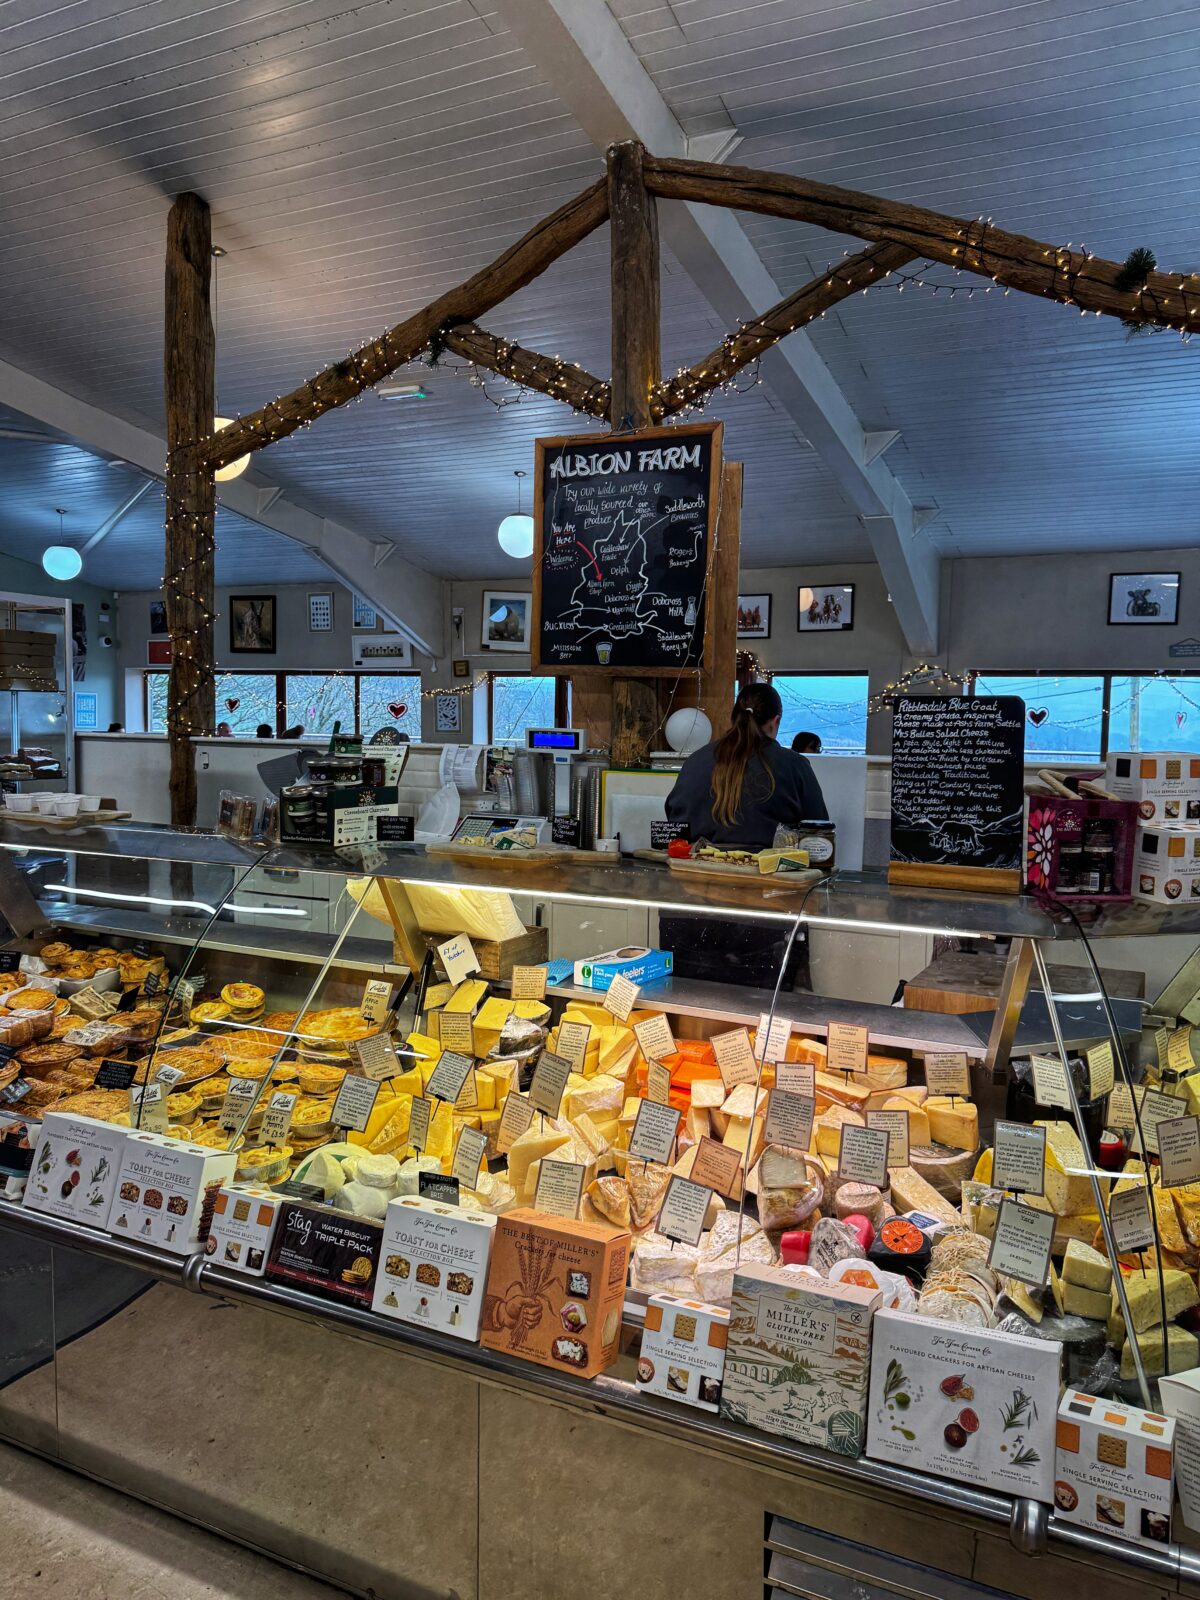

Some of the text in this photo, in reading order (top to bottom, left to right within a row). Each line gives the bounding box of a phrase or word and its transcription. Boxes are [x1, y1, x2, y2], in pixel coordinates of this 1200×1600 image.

[550, 445, 702, 478] ALBION FARM
[562, 483, 578, 500] Try
[580, 487, 595, 497] our
[597, 482, 616, 495] wide
[552, 522, 576, 533] You Are
[669, 559, 690, 569] Bakery
[610, 566, 630, 577] Delph
[652, 596, 683, 607] Dobcross
[899, 698, 999, 712] Ribblesdale Blue Goat
[922, 720, 943, 728] made
[893, 729, 909, 738] Mrs
[936, 729, 960, 738] Salad
[960, 729, 989, 737] Cheese
[961, 755, 970, 763] by
[893, 768, 990, 779] Swaledale Traditional
[913, 796, 946, 805] Cheddar
[267, 1122, 284, 1130] POTATO
[129, 1162, 192, 1186] TOAST FOR CHEESE
[140, 1175, 175, 1189] SELECTION BOX
[420, 1181, 457, 1195] FLATCAPPER
[430, 1191, 444, 1199] BRIE
[1017, 1207, 1040, 1219] Cornish
[321, 1223, 343, 1235] WATER
[314, 1230, 374, 1255] TRIPLE PACK
[502, 1227, 518, 1238] THE
[521, 1232, 541, 1243] BEST
[543, 1238, 553, 1247] OF
[394, 1230, 476, 1261] TOAST FOR CHEESE
[514, 1240, 544, 1255] Crackers
[558, 1253, 581, 1265] cheese
[410, 1247, 454, 1264] SELECTION BOX
[783, 1303, 814, 1319] The Best of
[766, 1308, 829, 1333] MILLER'S
[766, 1321, 826, 1342] GLUTEN-FREE
[776, 1333, 813, 1347] SELECTION
[646, 1344, 718, 1369] SINGLE SERVING SELECTION
[889, 1344, 1036, 1382] FLAVOURED CRACKERS FOR ARTISAN CHEESES
[1062, 1466, 1087, 1479] SINGLE
[1089, 1475, 1119, 1489] SERVING
[1121, 1485, 1162, 1501] SELECTION
